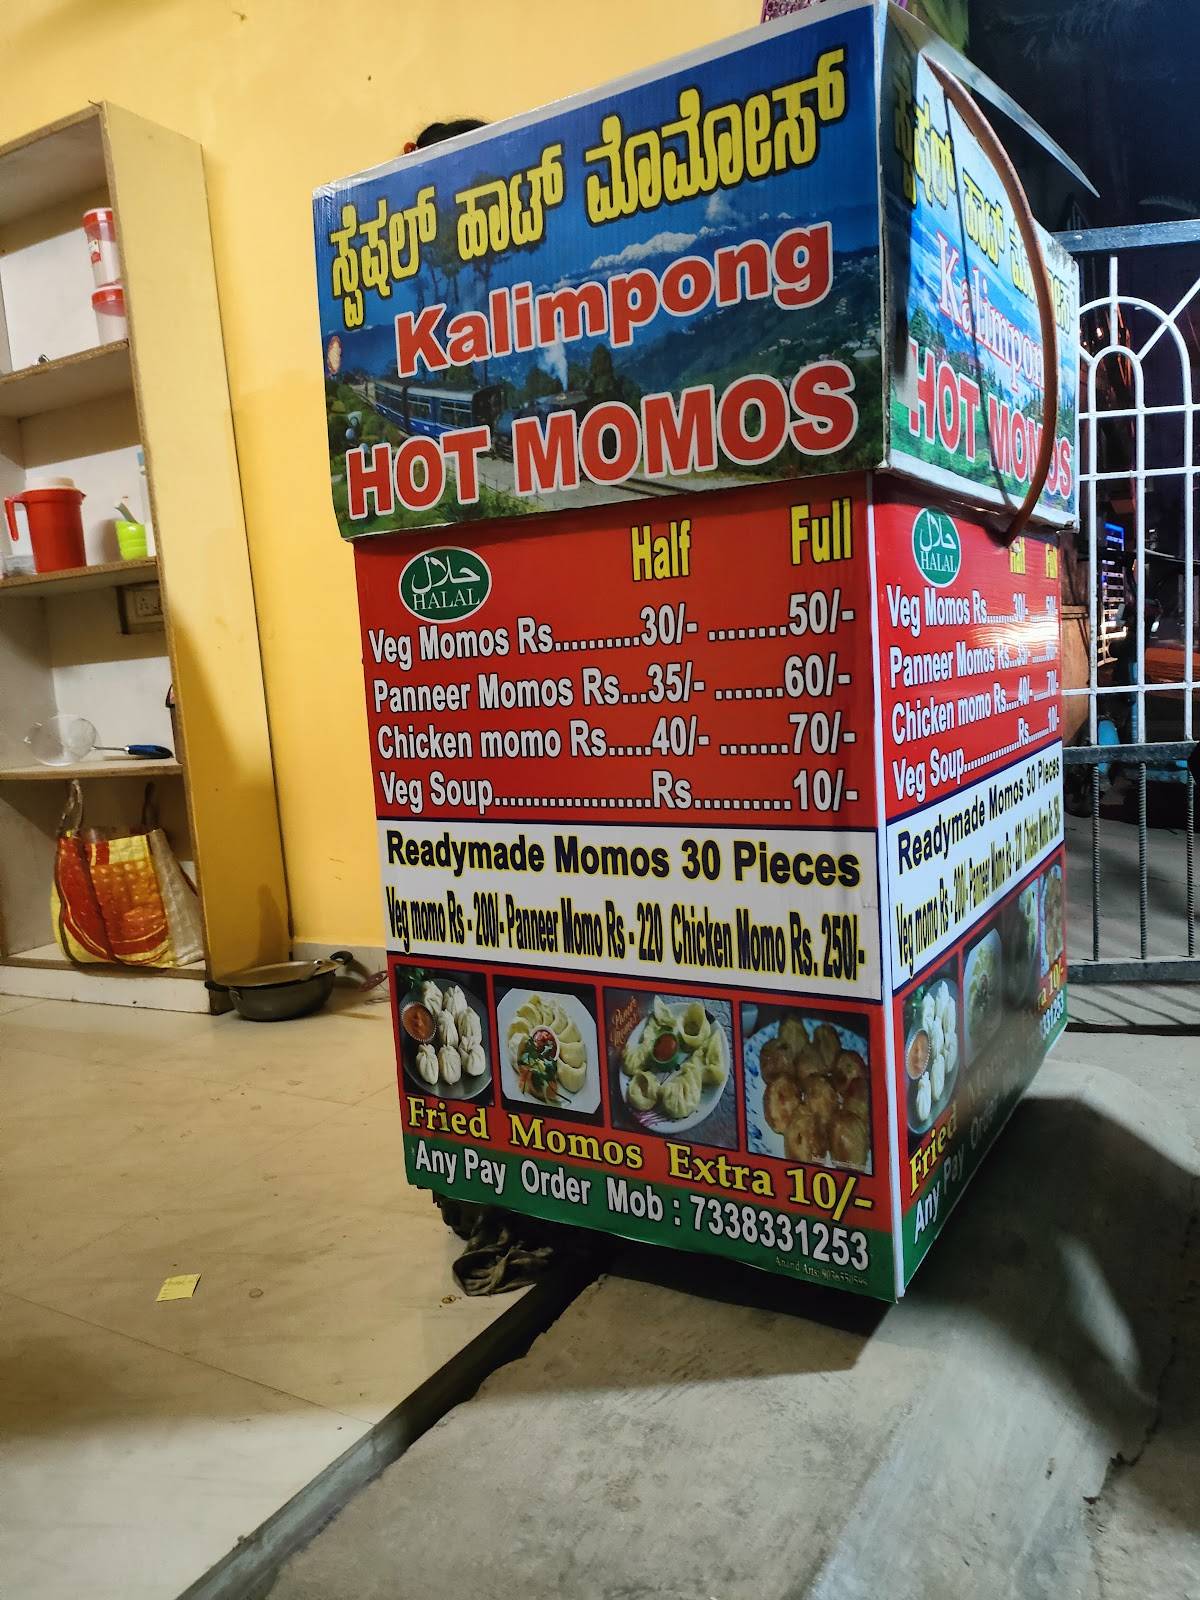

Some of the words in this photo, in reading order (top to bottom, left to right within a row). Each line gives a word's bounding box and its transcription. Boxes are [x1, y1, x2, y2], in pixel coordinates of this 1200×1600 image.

[455, 143, 564, 261] ಹಾಟ್
[396, 221, 833, 377] Kalimpong
[936, 231, 1044, 394] Kalimpon
[908, 338, 979, 463] HOT
[346, 427, 491, 520] HOT
[514, 361, 858, 496] MOMOS
[630, 519, 692, 581] Half
[790, 498, 853, 566] Full
[920, 551, 957, 573] HALAL
[411, 554, 481, 595] حلال
[412, 588, 481, 611] HALAL
[886, 584, 921, 637] Veg
[924, 586, 970, 627] Momos
[368, 628, 413, 671] Veg
[419, 623, 511, 662] Momos
[889, 646, 954, 689] Panneer
[956, 641, 996, 678] Momos
[373, 678, 472, 714] Panneer
[478, 672, 573, 711] Momos
[891, 700, 955, 745] Chicken
[957, 694, 991, 728] momo
[377, 723, 473, 760] Chicken
[480, 728, 562, 760] momo
[379, 771, 424, 813] Veg
[892, 758, 926, 803] Veg
[898, 795, 985, 875] Readymade
[989, 777, 1024, 821] Momos
[386, 830, 546, 877] Readymade
[554, 835, 670, 879] Momos
[681, 839, 722, 881] 30
[733, 840, 861, 887] Pieces
[385, 886, 410, 953] Veg
[410, 899, 447, 943] momo
[447, 890, 465, 945] Rs
[506, 894, 559, 953] Panneer
[560, 897, 603, 957] Momo
[605, 900, 626, 960] Rs
[637, 902, 664, 962] 220
[671, 903, 733, 968] Chicken
[736, 908, 786, 974] Momo
[789, 911, 818, 977] Rs.
[821, 913, 866, 981] 250/-
[896, 903, 914, 977] Veg
[406, 1096, 490, 1142] Fried
[510, 1113, 643, 1171] Momos
[667, 1143, 774, 1198] Extra
[785, 1168, 874, 1223] 10/-
[910, 1100, 958, 1196] Fried
[415, 1140, 457, 1185] Any
[464, 1150, 507, 1195] Pay
[520, 1159, 592, 1206] Order
[606, 1176, 663, 1222] Mob
[689, 1195, 870, 1273] 7338331253
[914, 1180, 940, 1244] Any
